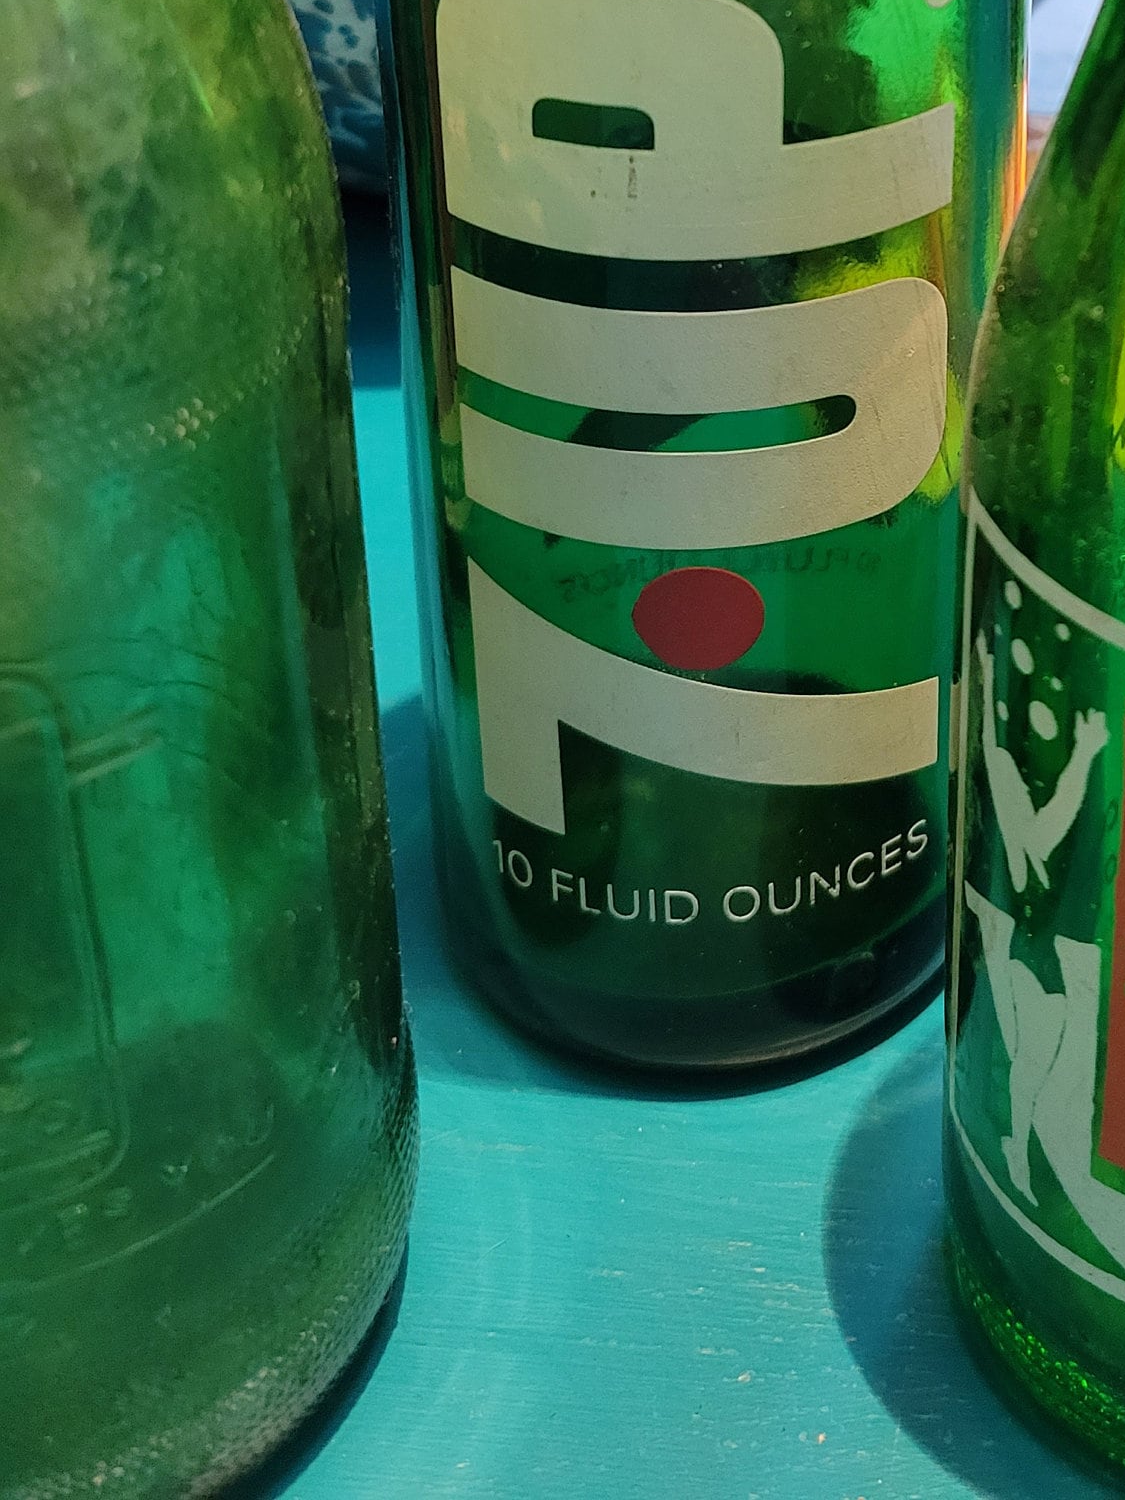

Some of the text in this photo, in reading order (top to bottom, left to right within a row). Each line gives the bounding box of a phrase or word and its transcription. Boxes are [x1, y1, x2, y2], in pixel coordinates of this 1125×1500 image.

[493, 818, 929, 926] 10 FLUID OUNCES
